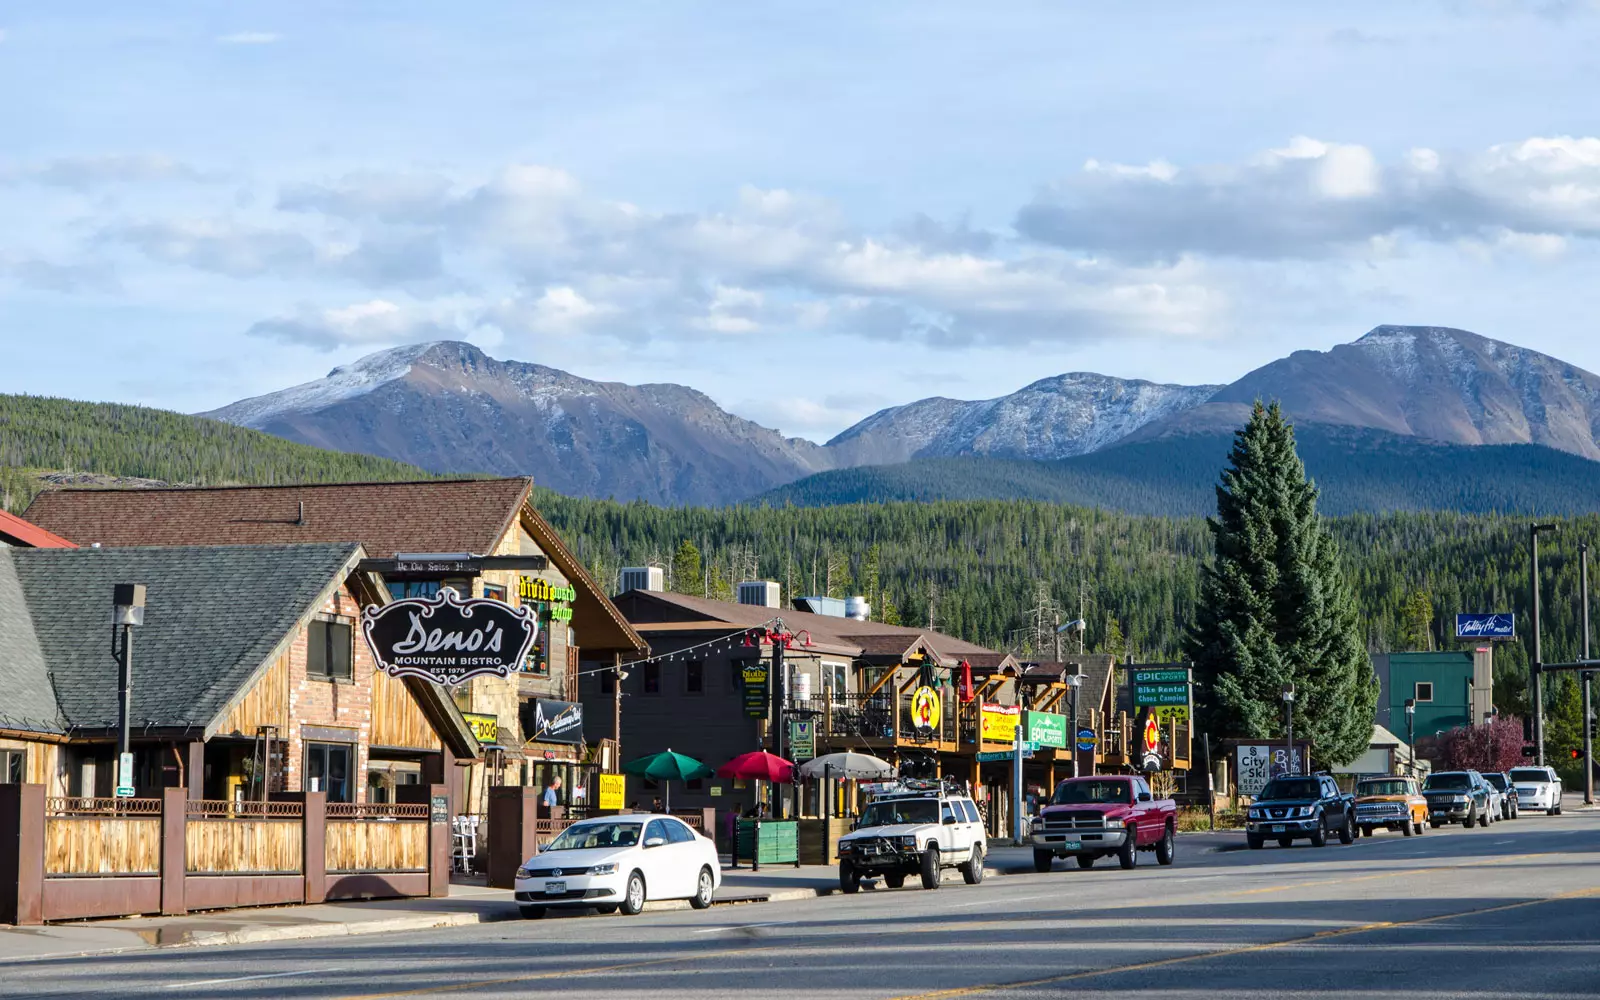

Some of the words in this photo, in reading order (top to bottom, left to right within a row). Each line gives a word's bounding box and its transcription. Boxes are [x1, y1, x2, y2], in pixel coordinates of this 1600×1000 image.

[552, 602, 573, 625] shop
[1458, 620, 1485, 636] Valley
[1484, 615, 1497, 632] Hi
[392, 611, 503, 655] Deno's
[394, 656, 456, 665] MOUNTAIN
[460, 656, 502, 665] BISTRO
[1136, 672, 1160, 681] EPIC
[1160, 694, 1186, 703] Camping
[1162, 707, 1185, 715] BAR
[478, 722, 496, 738] DOG
[1032, 727, 1048, 745] EPIC
[1242, 757, 1265, 768] City
[1249, 768, 1266, 777] Ski
